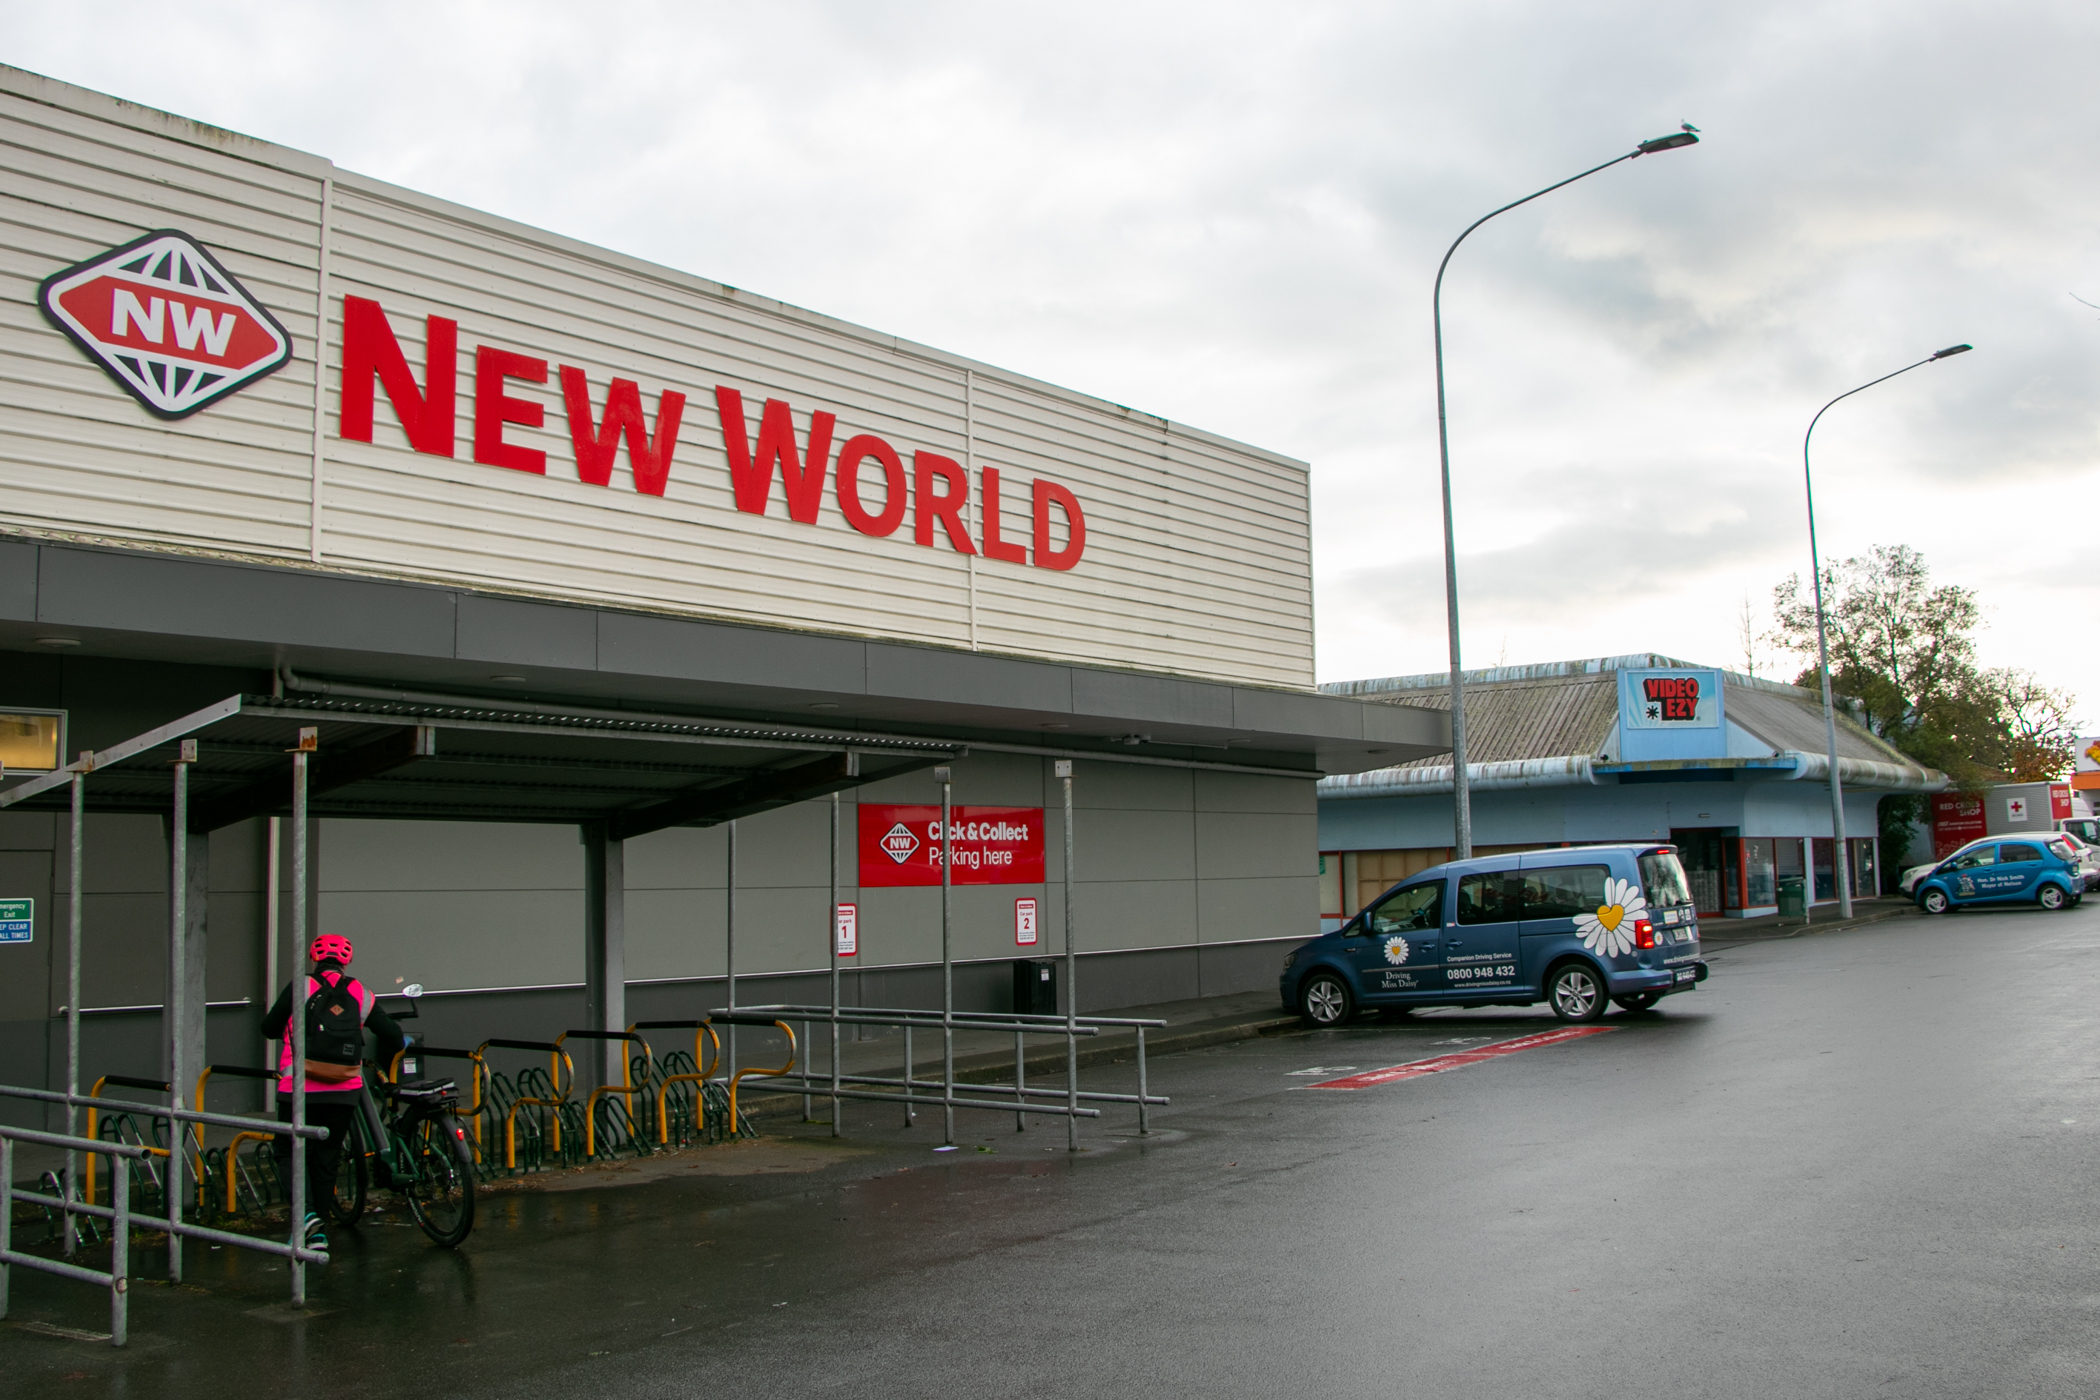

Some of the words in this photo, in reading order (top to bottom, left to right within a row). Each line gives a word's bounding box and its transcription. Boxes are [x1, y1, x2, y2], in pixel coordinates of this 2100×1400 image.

[111, 287, 236, 358] NW
[340, 293, 686, 497] NEW
[715, 384, 1086, 571] WORLD
[1645, 678, 1699, 699] VIDEO
[1664, 698, 1699, 718] EZY
[1959, 808, 1981, 816] SHOP
[928, 821, 966, 840] Clck
[890, 837, 910, 849] NW
[929, 846, 979, 870] Paking
[983, 846, 1012, 865] here
[1024, 917, 1030, 930] 2
[842, 925, 847, 939] 1
[1385, 971, 1411, 980] Driving
[1447, 968, 1472, 980] 0800
[1474, 967, 1494, 978] 948
[1495, 965, 1515, 976] 432
[1381, 980, 1397, 988] Miss
